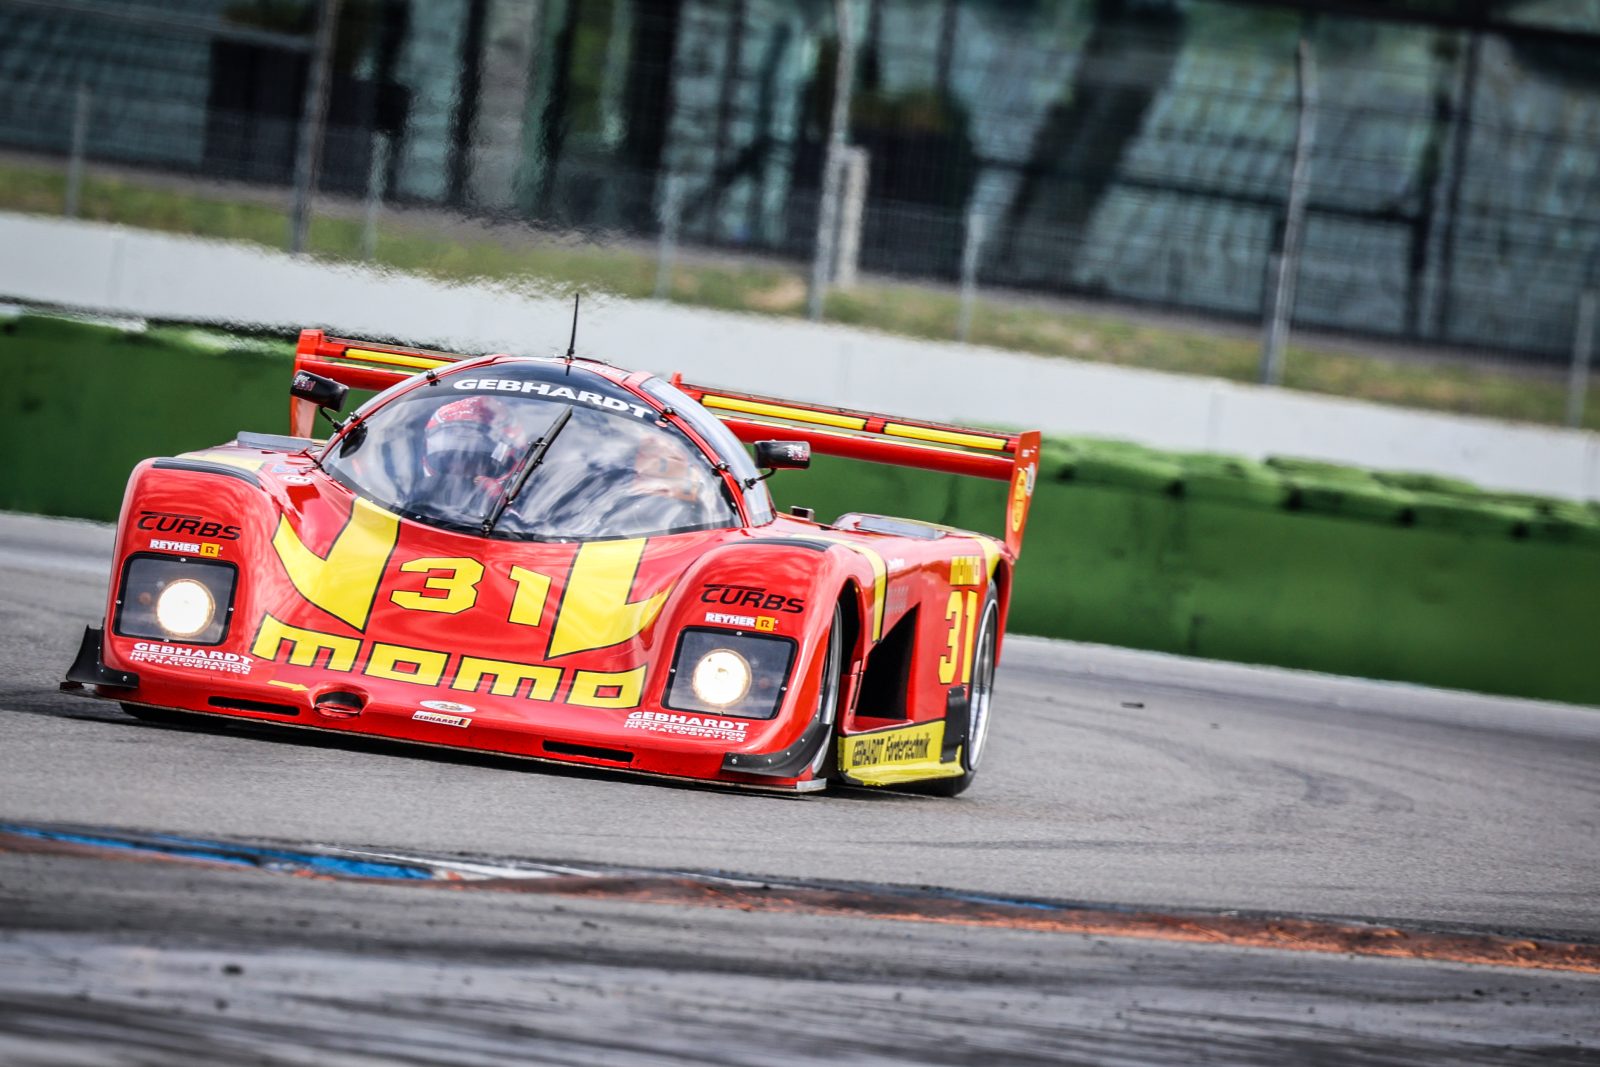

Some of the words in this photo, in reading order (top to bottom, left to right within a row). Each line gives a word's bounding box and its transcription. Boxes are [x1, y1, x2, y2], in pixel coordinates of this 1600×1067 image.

[453, 378, 653, 418] GEBHARDT
[138, 511, 241, 540] CURBS
[150, 539, 200, 553] REYHER
[390, 556, 551, 627] 31
[701, 584, 805, 613] CURBS
[705, 612, 755, 627] REYHER
[938, 590, 978, 685] 31
[131, 651, 164, 659] NEXT
[169, 656, 251, 672] GENERATION
[134, 643, 254, 665] GEBHARDT
[129, 656, 250, 675] INTRALOGISTICS
[414, 714, 458, 725] GEBHARDT
[628, 712, 749, 730] GEBHARDT
[624, 724, 745, 742] INTRALOGISTICS
[664, 724, 746, 737] GENERATION
